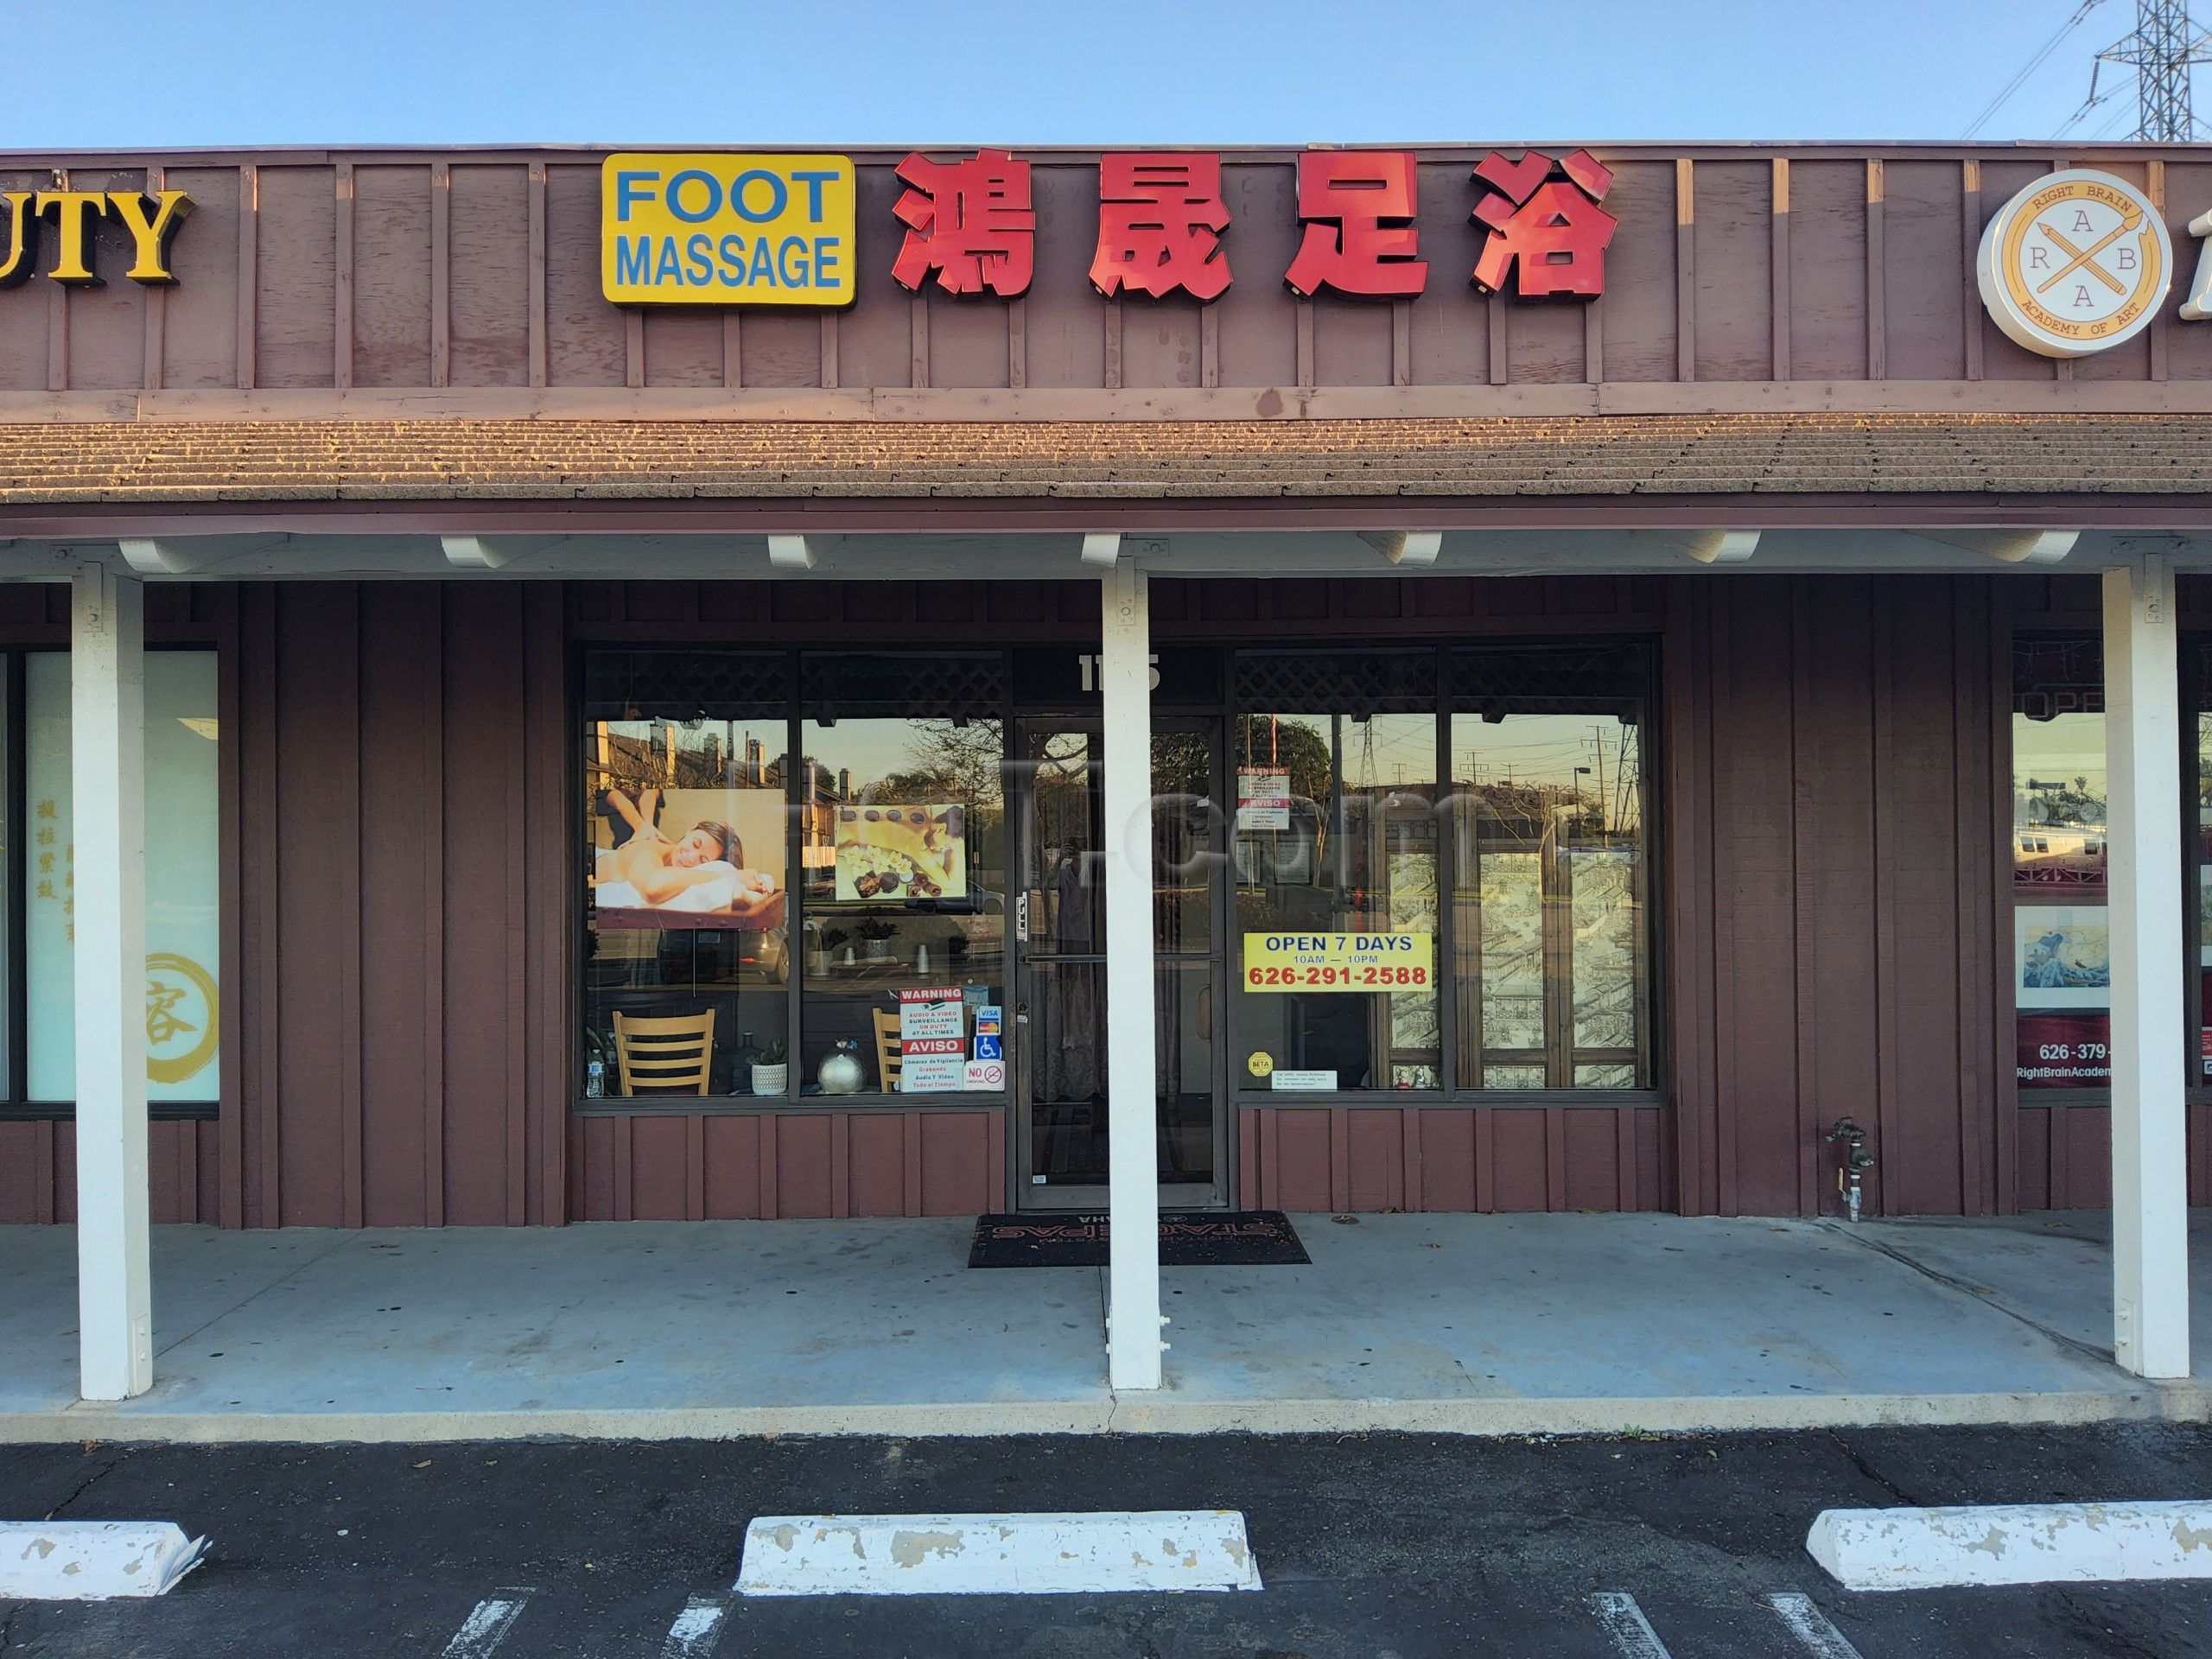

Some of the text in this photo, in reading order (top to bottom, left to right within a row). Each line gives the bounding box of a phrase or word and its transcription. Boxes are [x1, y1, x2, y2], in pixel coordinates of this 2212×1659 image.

[617, 169, 840, 223] FOOT
[2032, 185, 2133, 213] RIGHT BRAIN
[2071, 210, 2094, 232] A
[616, 233, 841, 288] MASSAGE
[2030, 246, 2137, 270] R B
[2072, 285, 2094, 307] A
[2021, 299, 2140, 336] ACADEMY OF ART
[1266, 936, 1413, 951] OPEN 7 DAYS
[1293, 955, 1325, 964] 10AM
[1347, 955, 1379, 964] 10PM
[1249, 966, 1427, 986] 626-291-2588
[901, 988, 962, 1000] WARNING
[909, 1040, 958, 1052] AVISO
[969, 1067, 982, 1077] NO
